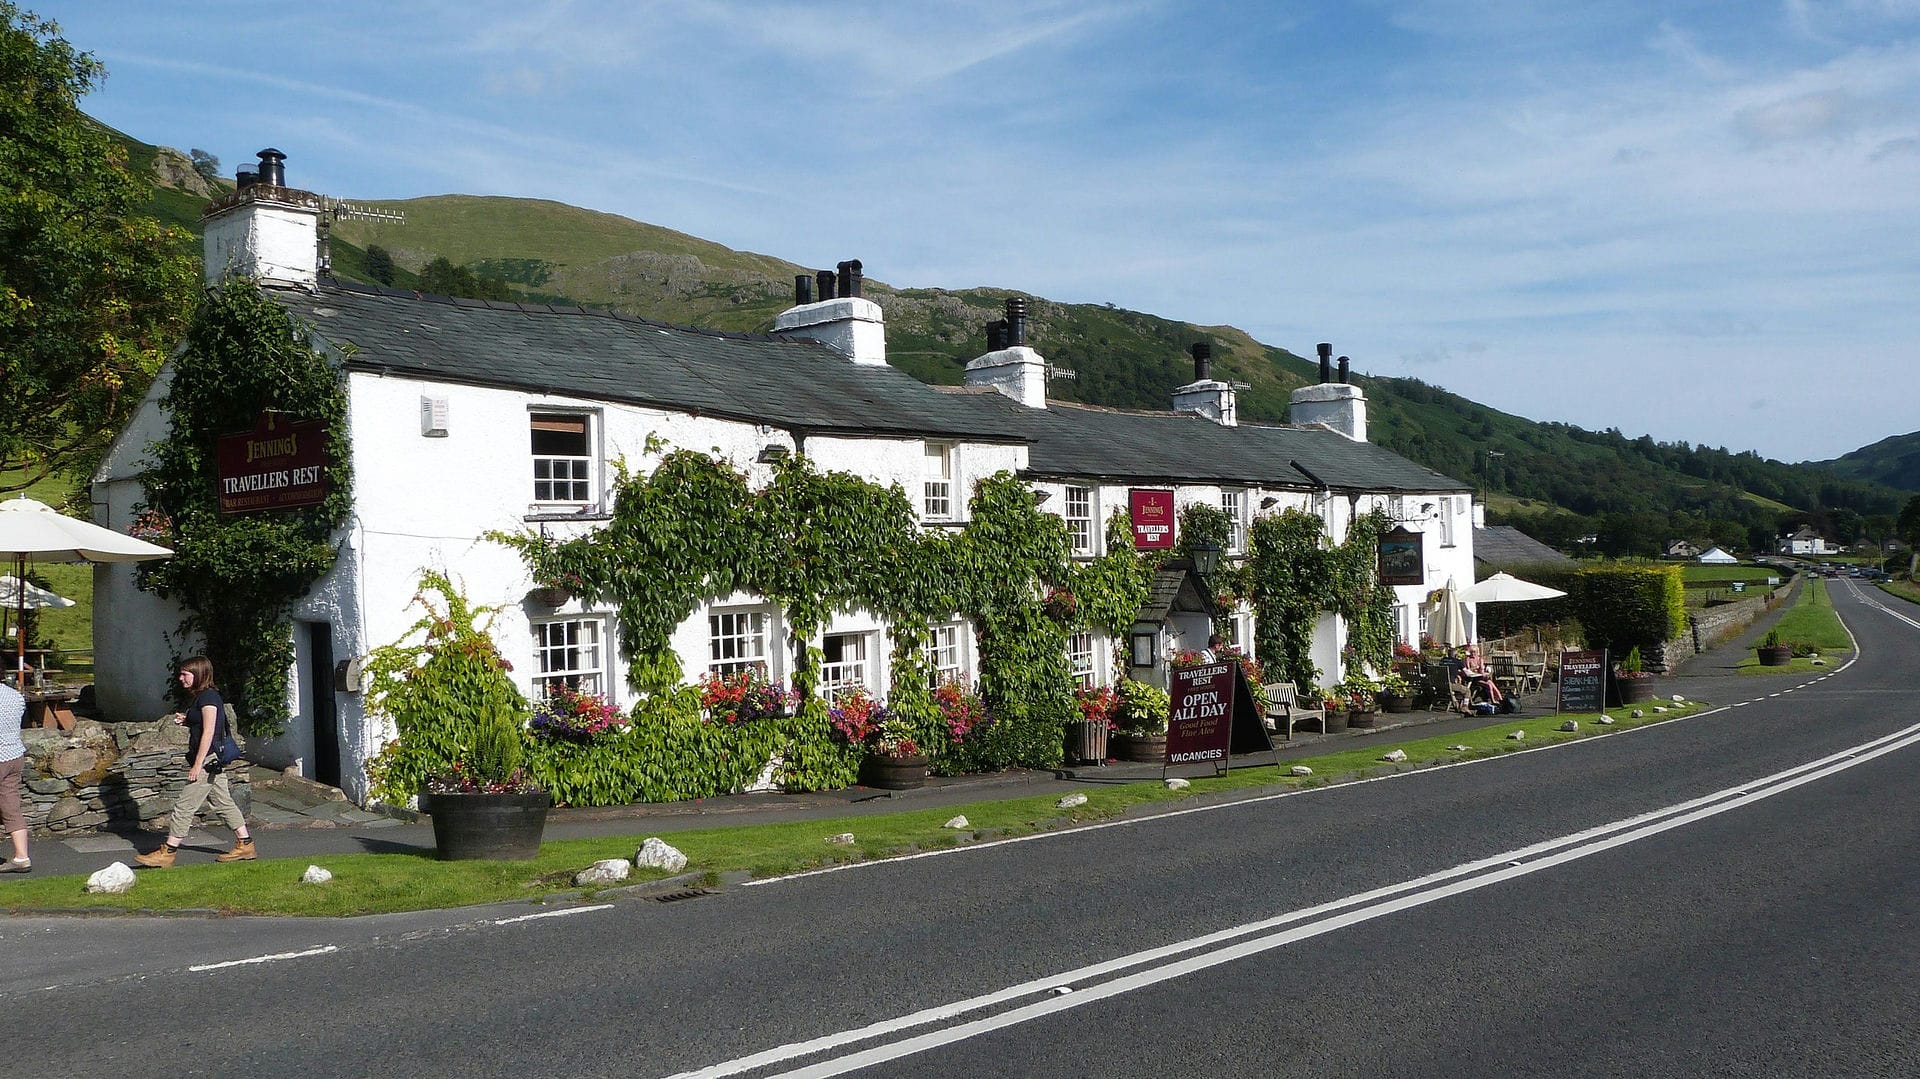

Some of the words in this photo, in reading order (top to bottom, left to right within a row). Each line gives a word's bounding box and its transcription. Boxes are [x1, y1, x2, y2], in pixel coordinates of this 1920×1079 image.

[247, 433, 297, 463] JENNINGS
[223, 471, 288, 494] TRAVELLERS
[293, 465, 319, 485] REST
[1137, 524, 1169, 533] TRAVELLERS
[1179, 665, 1228, 680] TRAVELLERS
[1192, 676, 1213, 686] REST
[1183, 691, 1218, 707] OPEN
[1173, 707, 1197, 721] ALL
[1200, 702, 1227, 718] DAY
[1180, 720, 1199, 730] Good
[1200, 718, 1218, 727] Food
[1181, 729, 1197, 738] Fine
[1198, 727, 1215, 736] Ales
[1171, 749, 1222, 763] VACANCIES
